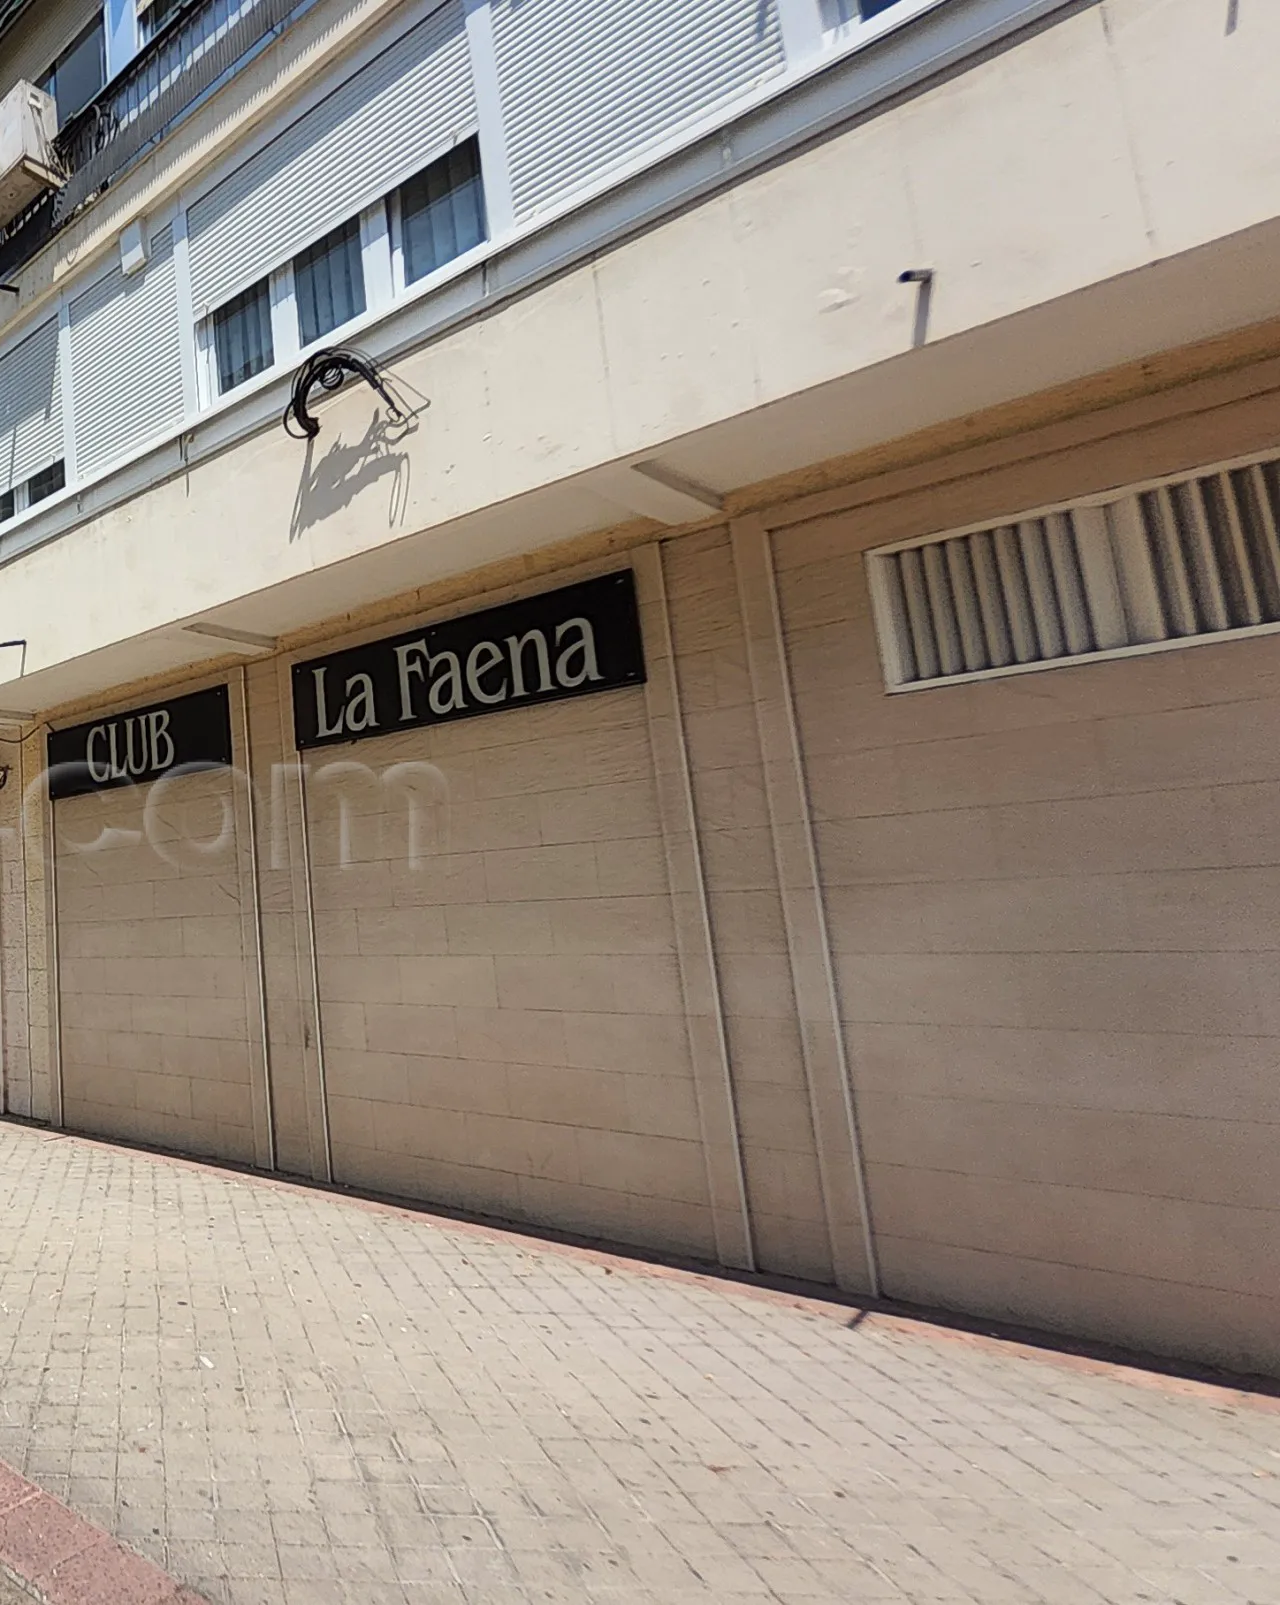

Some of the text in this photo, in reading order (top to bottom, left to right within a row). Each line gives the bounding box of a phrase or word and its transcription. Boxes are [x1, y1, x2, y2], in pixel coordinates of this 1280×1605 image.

[312, 617, 605, 738] La Faena
[86, 710, 175, 783] CLUB
